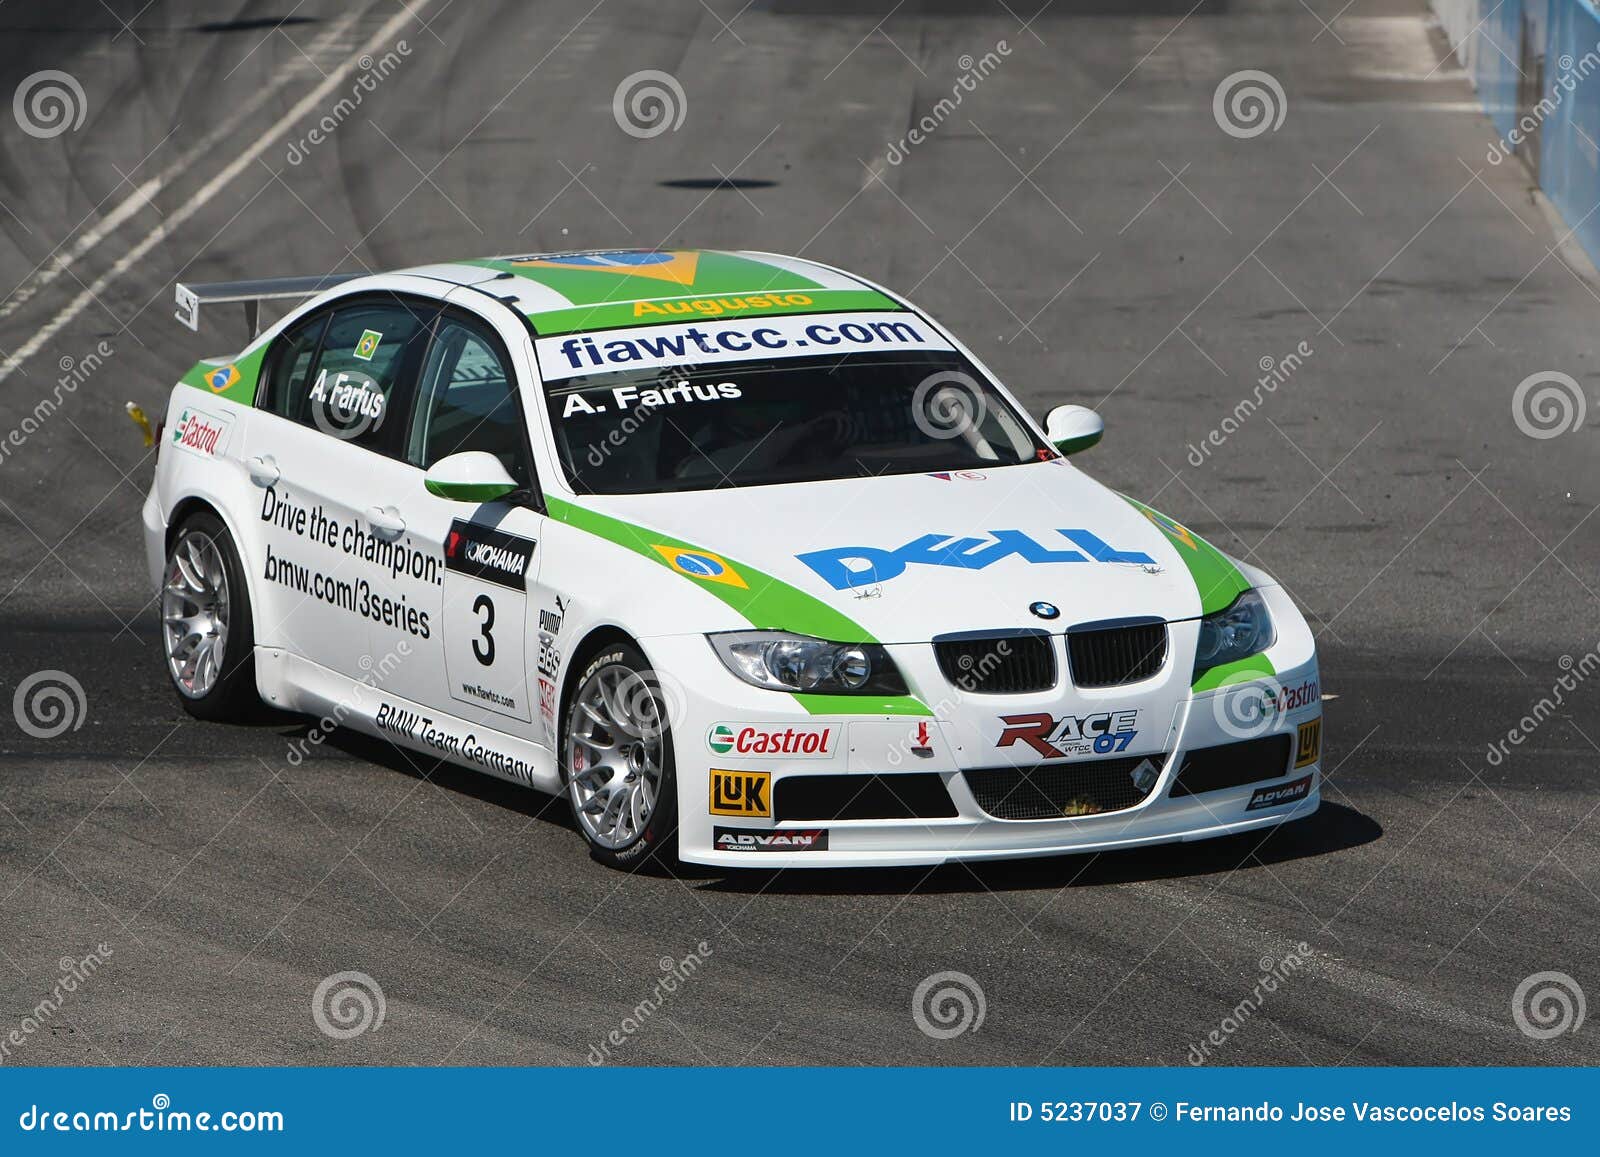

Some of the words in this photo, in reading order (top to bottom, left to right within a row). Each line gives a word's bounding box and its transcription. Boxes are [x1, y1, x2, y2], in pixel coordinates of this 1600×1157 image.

[633, 293, 814, 317] Augusto
[560, 319, 926, 370] fiawtcc.com
[309, 368, 328, 402] A.
[329, 373, 384, 418] Farfus
[562, 393, 607, 418] A.
[611, 381, 742, 410] Farfus
[181, 415, 222, 455] Castrol
[261, 485, 306, 536] Drive
[309, 506, 339, 548] the
[342, 519, 443, 586] champion:
[465, 540, 525, 575] YOKOHAMA
[793, 529, 1158, 590] DELL
[264, 544, 430, 640] bmw.com/3series
[471, 594, 495, 666] 3
[539, 609, 561, 635] PUMA
[578, 651, 624, 690] ADVAN
[462, 683, 516, 708] www.fiawtcc.com
[376, 703, 420, 740] BMW
[420, 717, 459, 754] Team
[461, 734, 535, 787] Germany
[736, 727, 830, 753] Castrol
[996, 709, 1137, 759] RACE
[1064, 744, 1091, 752] WTCC
[1093, 730, 1138, 754] 07
[717, 833, 812, 845] ADVAN
